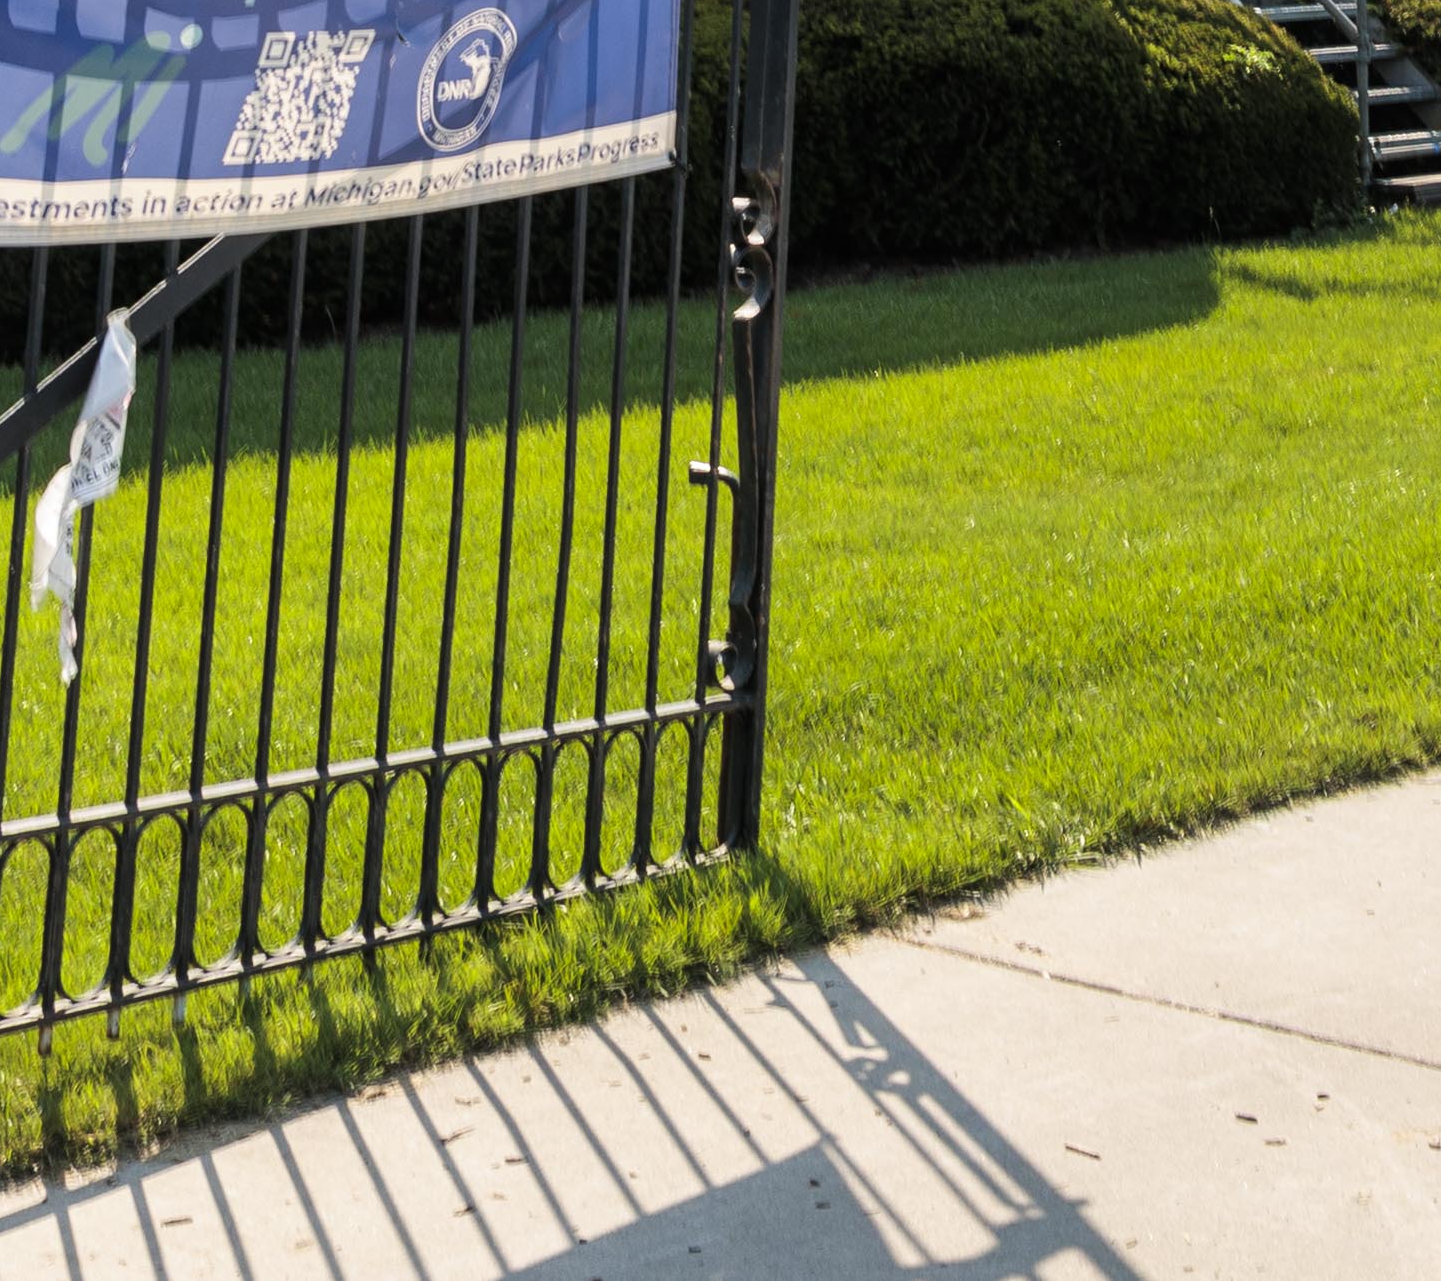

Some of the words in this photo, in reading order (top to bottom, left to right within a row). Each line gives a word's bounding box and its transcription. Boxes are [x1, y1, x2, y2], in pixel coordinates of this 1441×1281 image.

[437, 79, 473, 103] DNR
[142, 190, 167, 215] in
[175, 187, 263, 216] action
[270, 179, 297, 210] at
